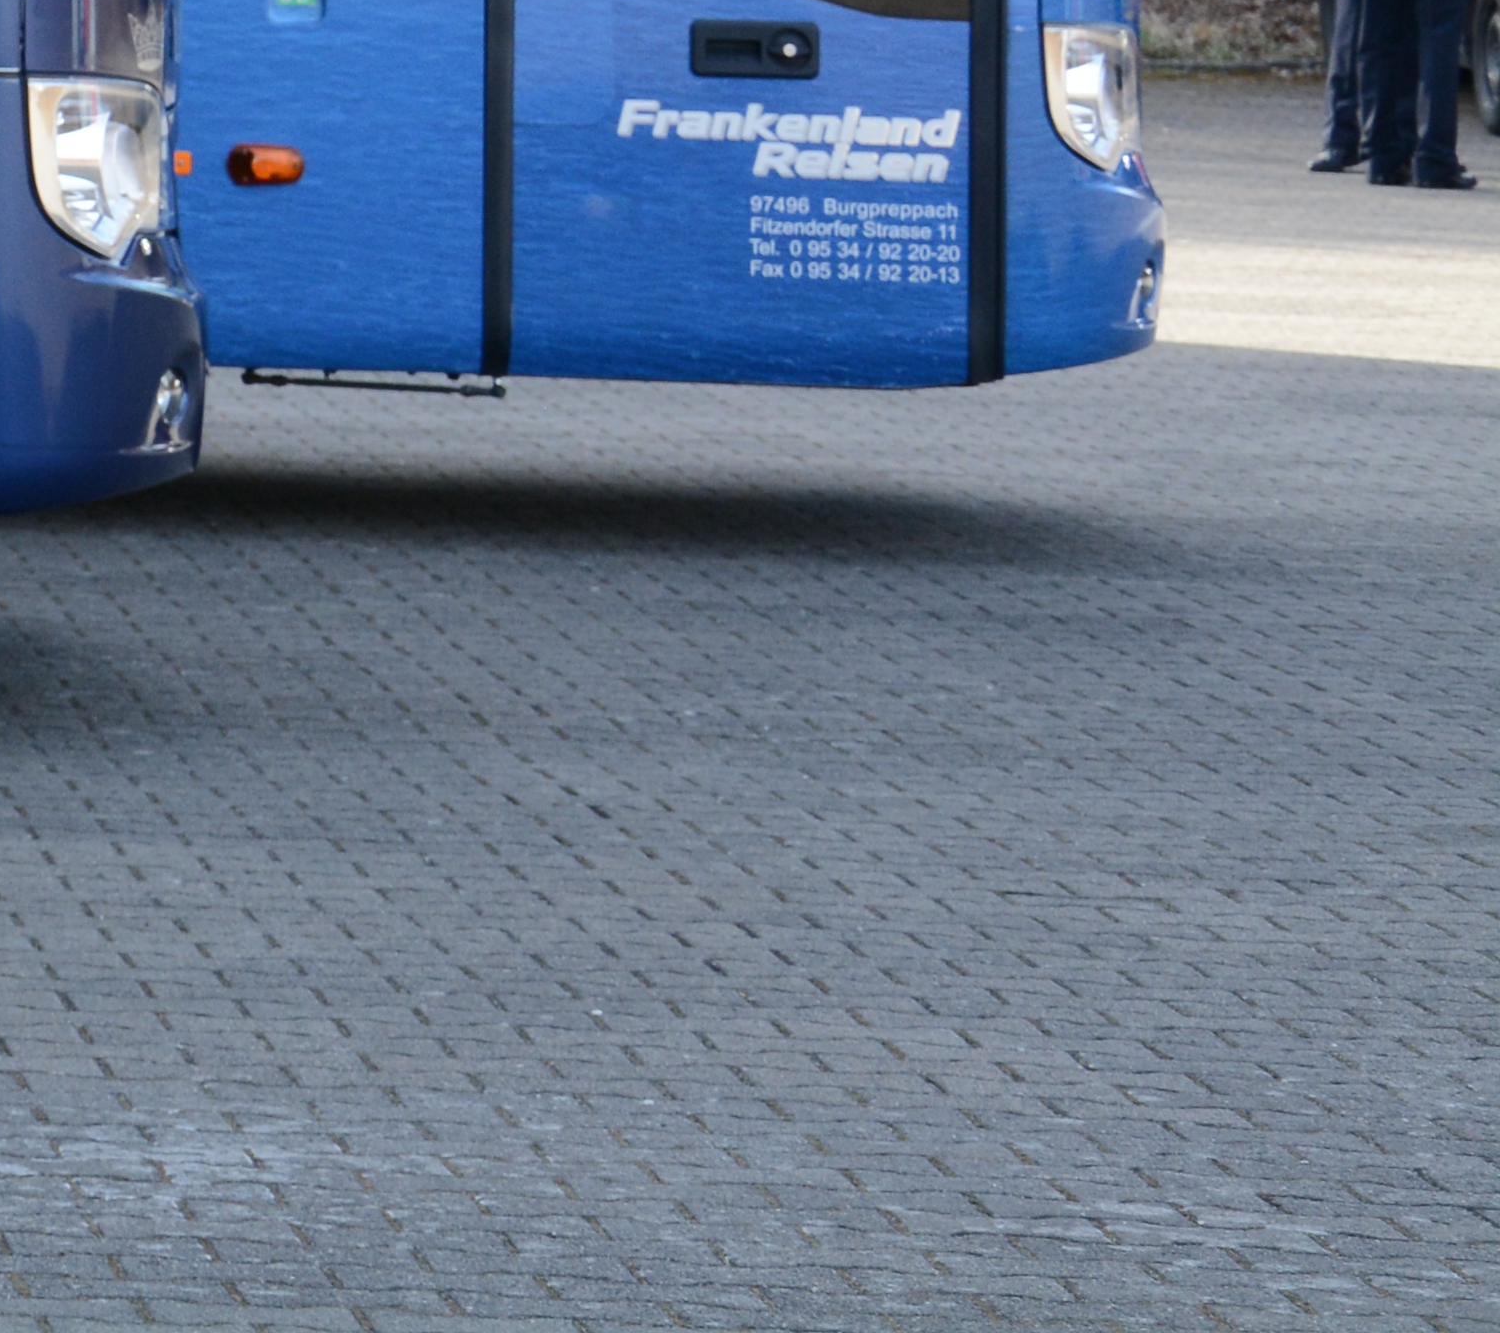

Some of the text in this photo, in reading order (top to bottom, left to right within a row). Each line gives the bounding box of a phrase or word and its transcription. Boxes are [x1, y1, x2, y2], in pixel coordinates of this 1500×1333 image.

[617, 98, 961, 148] Frankenland
[752, 140, 949, 183] Reisen
[749, 195, 958, 221] 97496 Burgpreppach
[751, 216, 957, 240] Fitzendorfer Strasse 11
[749, 238, 780, 256] Tel.
[808, 241, 831, 258] 95
[837, 242, 859, 258] 34
[878, 243, 902, 260] 92
[908, 245, 960, 263] 20-20
[750, 260, 784, 278] Fax
[808, 262, 831, 280] 95
[838, 263, 860, 280] 34
[878, 265, 902, 282] 92
[908, 265, 960, 284] 20-13
